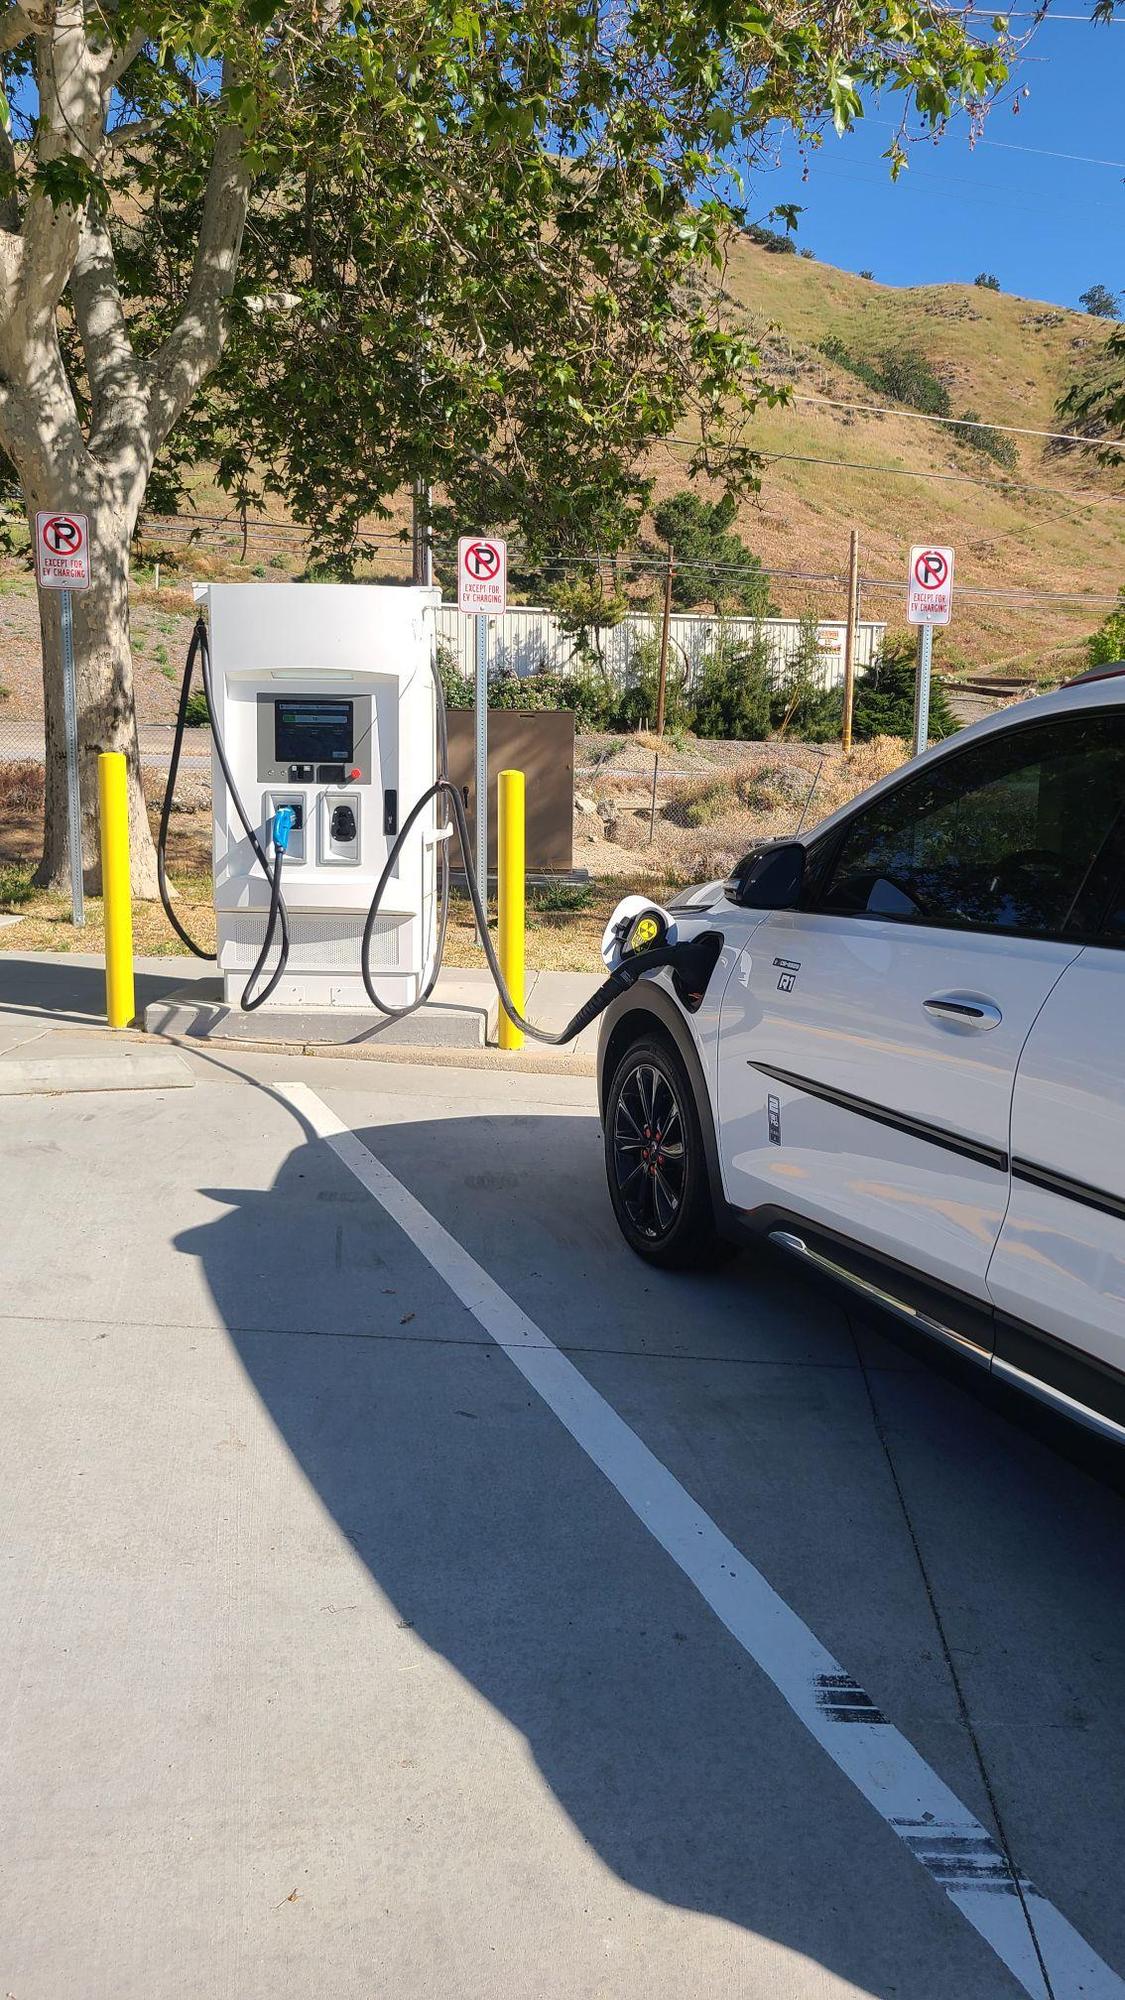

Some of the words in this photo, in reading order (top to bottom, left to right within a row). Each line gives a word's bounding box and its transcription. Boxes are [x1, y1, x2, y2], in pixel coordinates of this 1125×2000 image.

[45, 559, 68, 568] EXCEPT
[70, 560, 83, 569] FOR
[42, 568, 51, 576] EV
[53, 569, 86, 578] CHARGING
[465, 584, 486, 593] EXCEPT
[489, 585, 500, 594] FOR
[463, 593, 471, 601] EV
[473, 594, 502, 603] CHARGING
[913, 593, 934, 603] EXCEPT
[911, 603, 919, 611] EV
[920, 603, 947, 613] CHARGING
